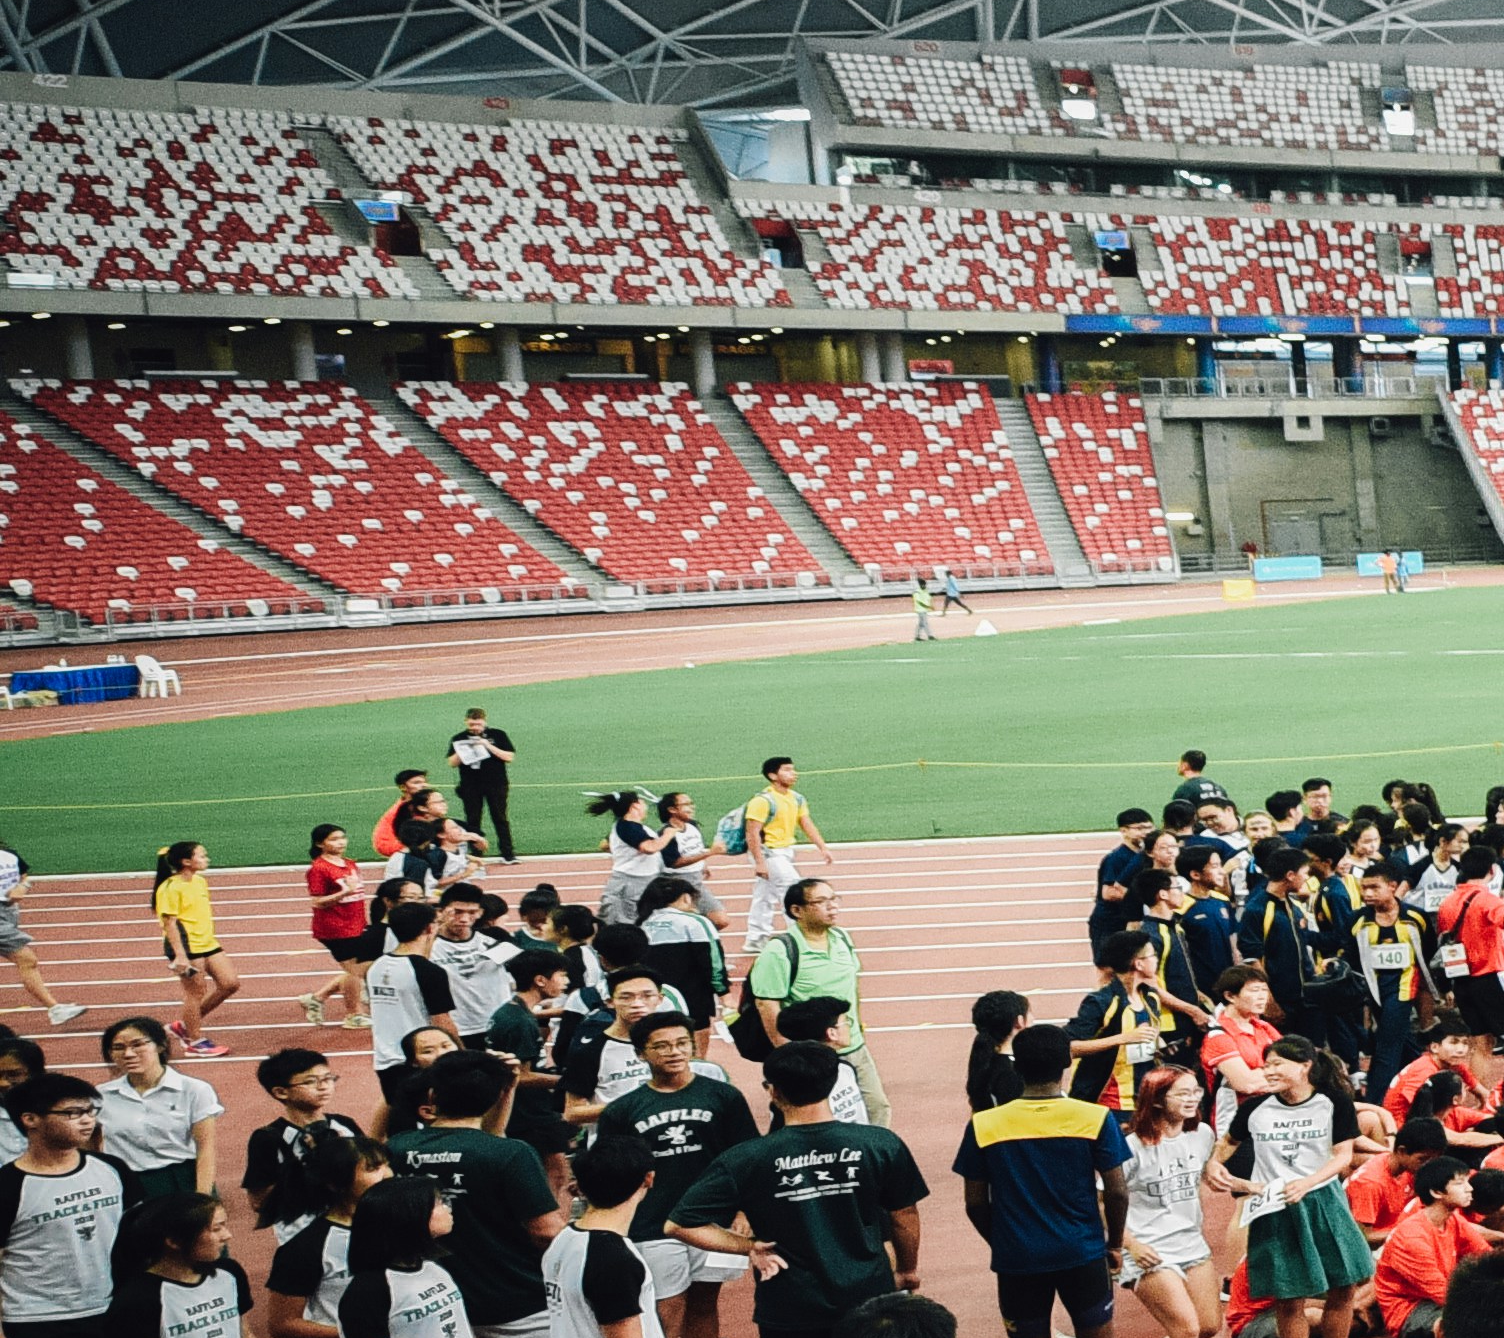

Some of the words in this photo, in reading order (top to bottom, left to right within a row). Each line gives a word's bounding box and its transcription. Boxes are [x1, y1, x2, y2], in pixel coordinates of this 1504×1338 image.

[1377, 951, 1403, 965] 140
[634, 1107, 713, 1134] RAFFLES
[1273, 1120, 1313, 1130] RAFFLES
[1256, 1131, 1290, 1141] TRACK
[406, 1150, 462, 1168] Kynaston
[774, 1149, 838, 1173] Matthew
[839, 1147, 862, 1164] Lee
[54, 1187, 102, 1207] RAFFLES
[30, 1203, 81, 1226] TRACK
[186, 1297, 225, 1316] RAFFLES
[168, 1317, 207, 1338] TRACK
